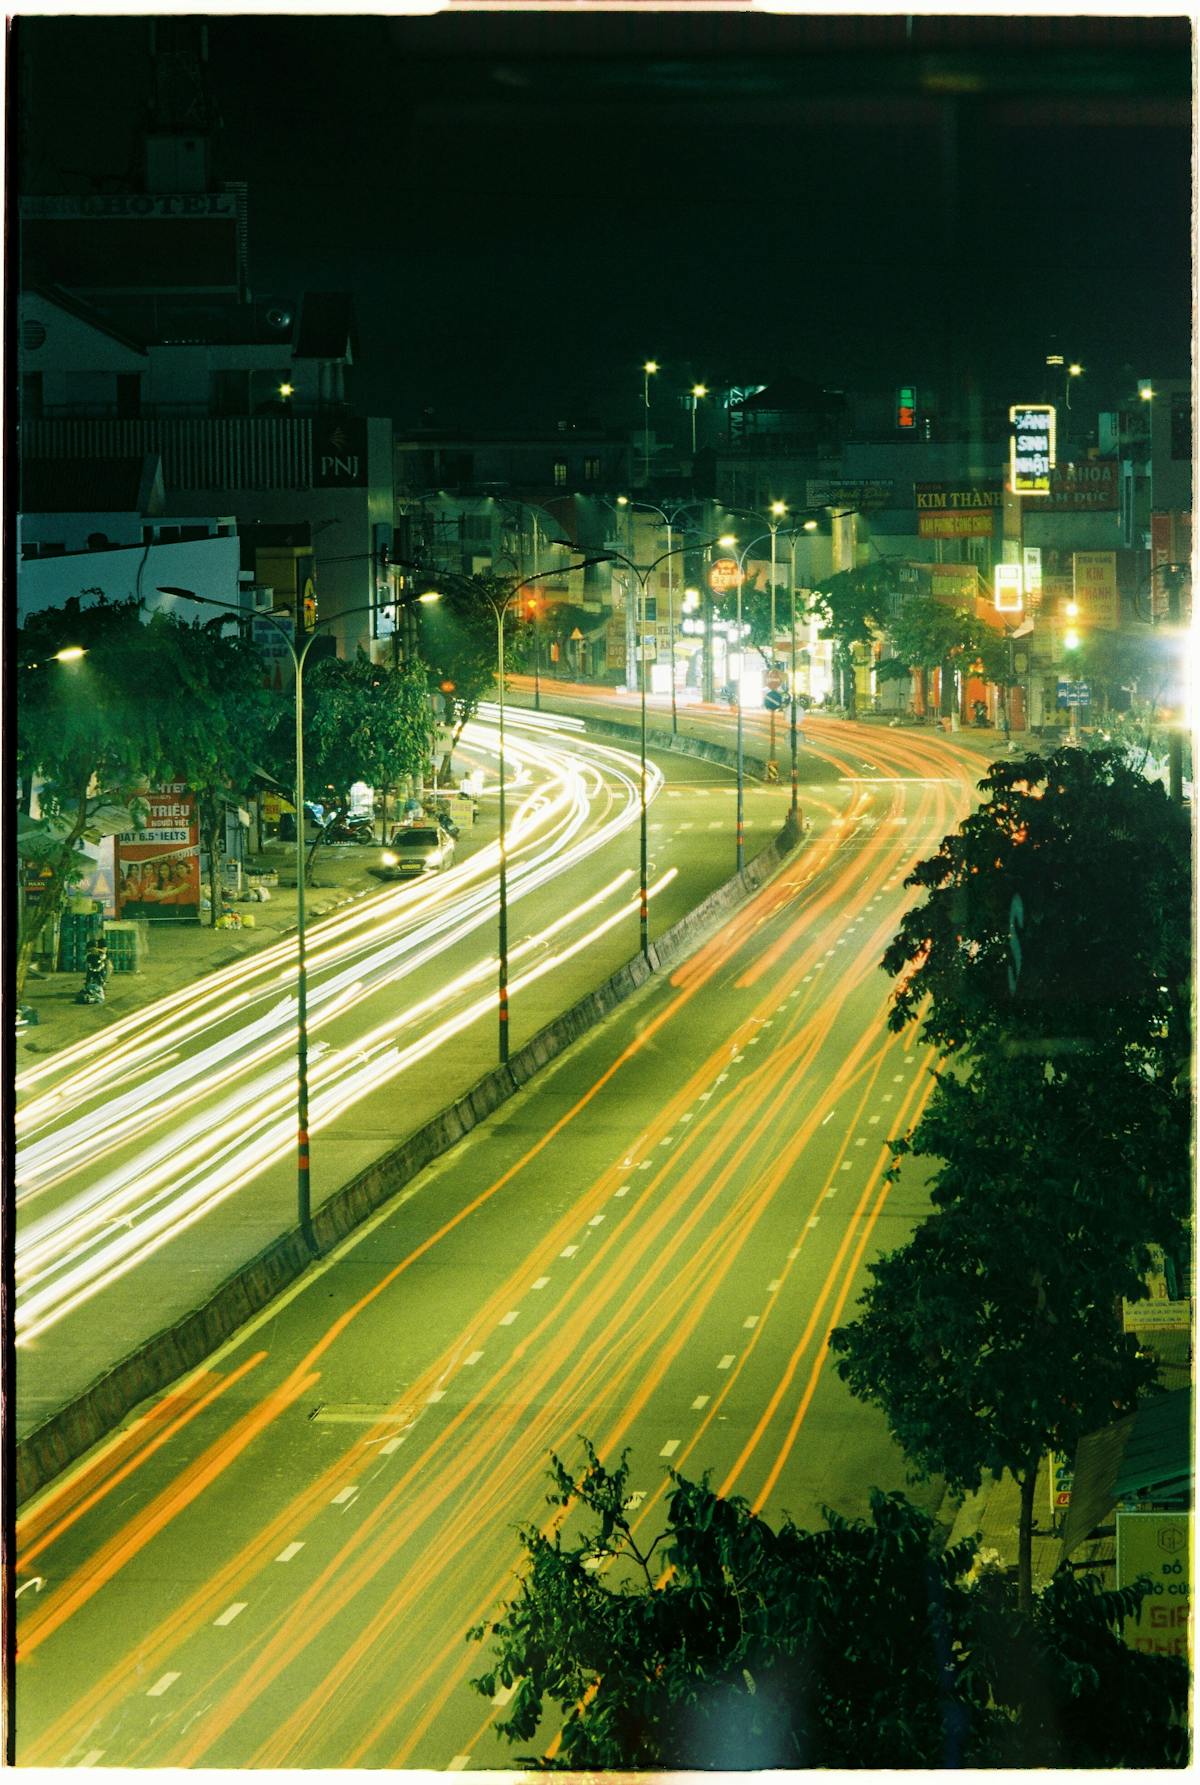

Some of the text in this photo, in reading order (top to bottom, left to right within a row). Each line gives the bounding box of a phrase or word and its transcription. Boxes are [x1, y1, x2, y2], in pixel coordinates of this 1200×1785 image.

[97, 195, 230, 215] HOTEL
[1017, 435, 1048, 451] SINH
[321, 456, 359, 478] PNJ
[917, 493, 947, 508] KIM
[151, 803, 190, 819] TRIỆU
[160, 831, 187, 841] IELTS
